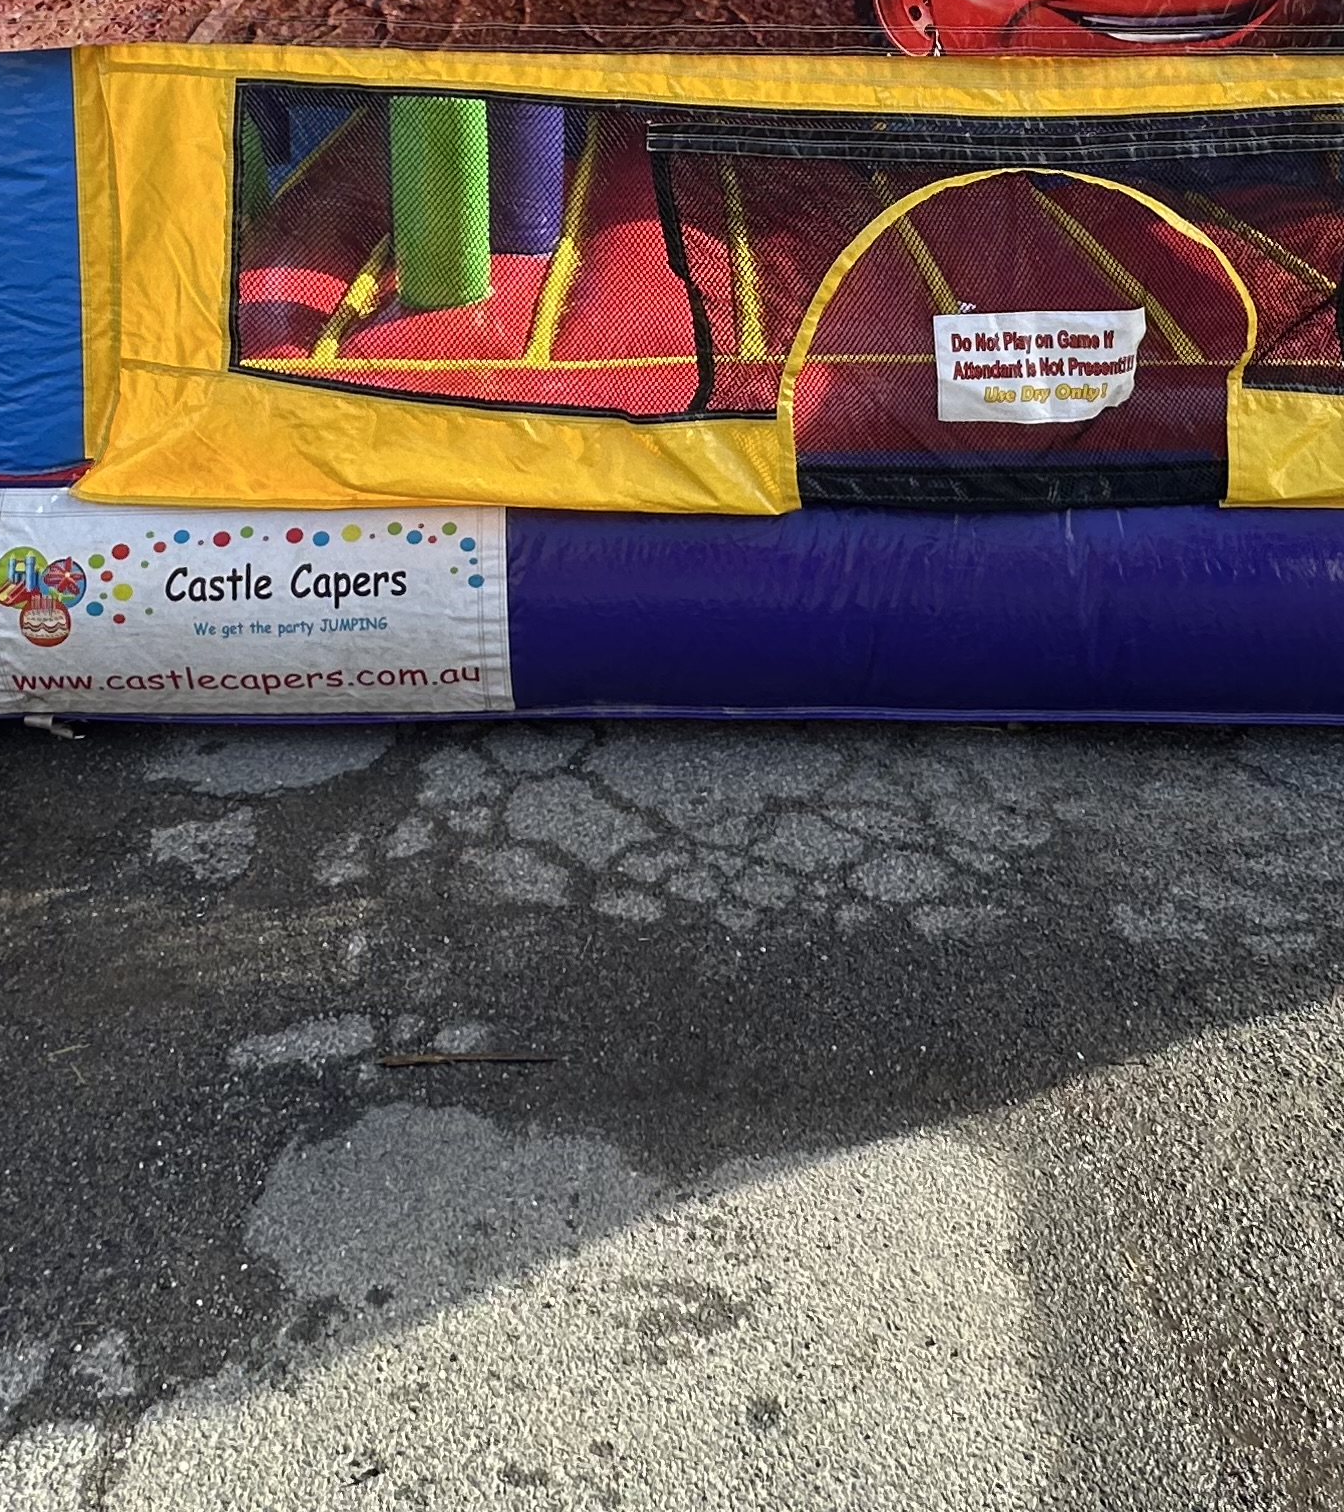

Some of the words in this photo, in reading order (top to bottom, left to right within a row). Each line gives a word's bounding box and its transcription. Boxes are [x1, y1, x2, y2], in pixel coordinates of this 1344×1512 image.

[950, 333, 972, 353] Do
[974, 332, 1002, 352] Not
[1002, 331, 1032, 354] Play
[1034, 333, 1054, 350] on
[1056, 329, 1100, 350] Game
[952, 359, 1024, 381] Attendant
[1025, 357, 1037, 378] Is
[1039, 356, 1065, 378] Not
[983, 386, 1016, 404] Use
[1020, 385, 1052, 404] Dry
[164, 564, 273, 604] Castle
[289, 564, 409, 610] Capers
[193, 621, 217, 637] We
[220, 622, 246, 639] get
[248, 621, 273, 635] the
[277, 619, 315, 638] party
[319, 616, 389, 634] JUMPING
[11, 663, 482, 696] www.castlecapers.com.au
